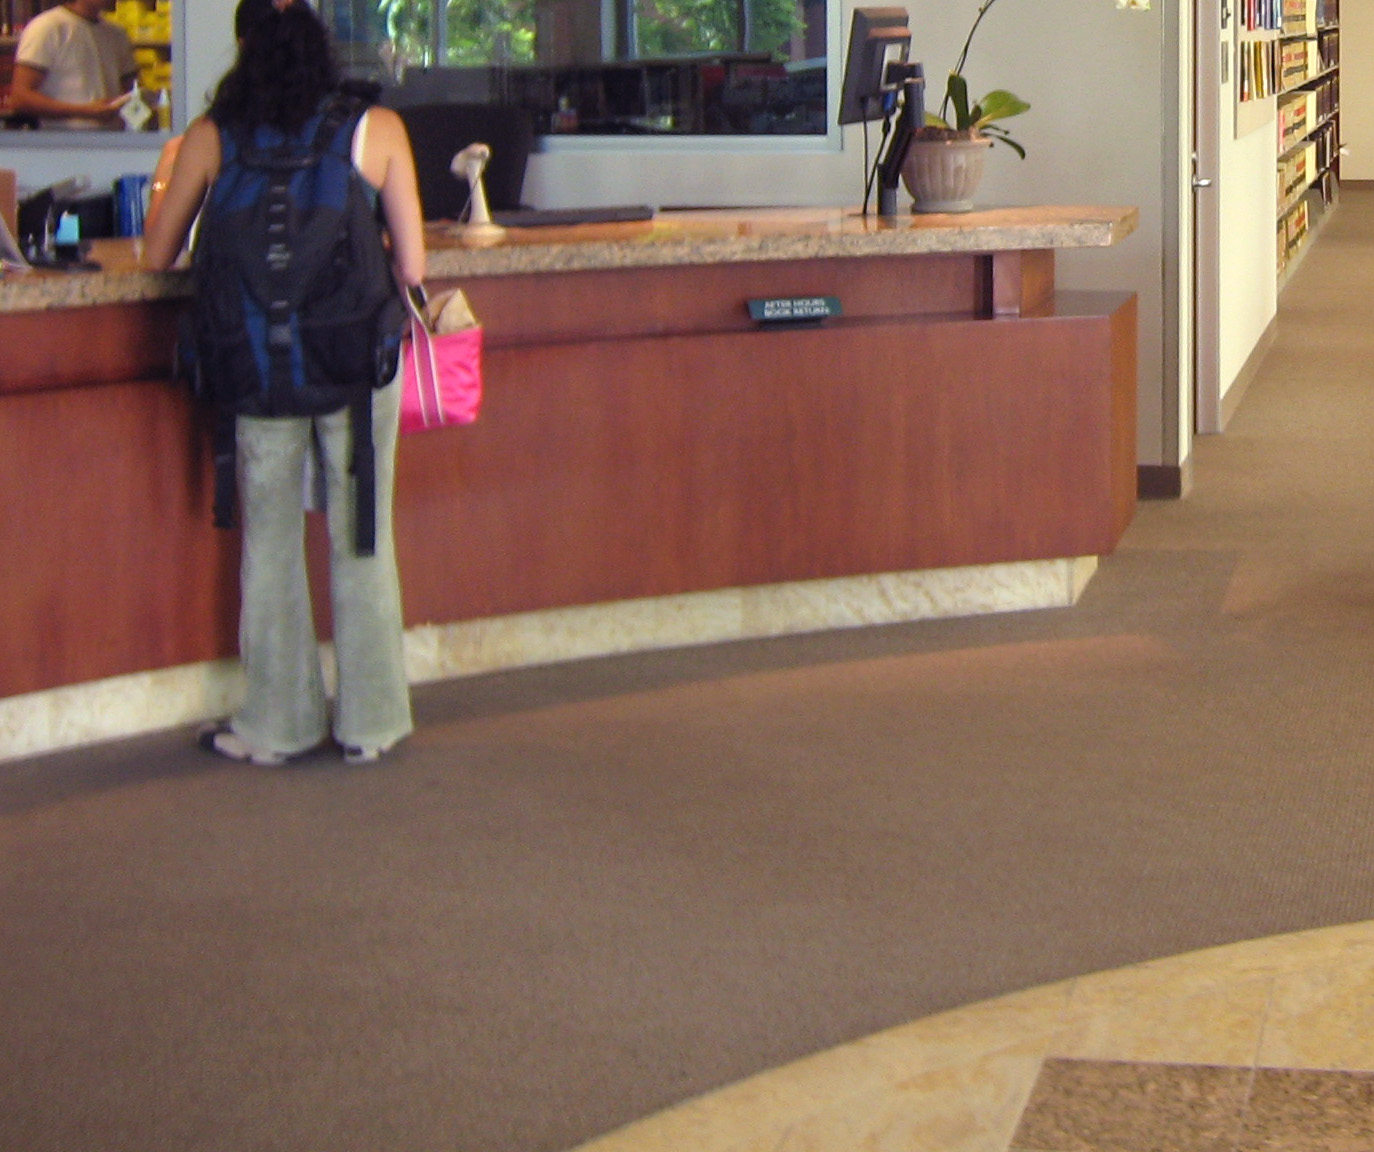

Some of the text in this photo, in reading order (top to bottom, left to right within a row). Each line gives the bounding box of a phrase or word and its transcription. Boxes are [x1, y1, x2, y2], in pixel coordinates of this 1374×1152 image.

[765, 298, 825, 308] AFTER HOURS
[764, 306, 830, 317] BOOK RETURN
